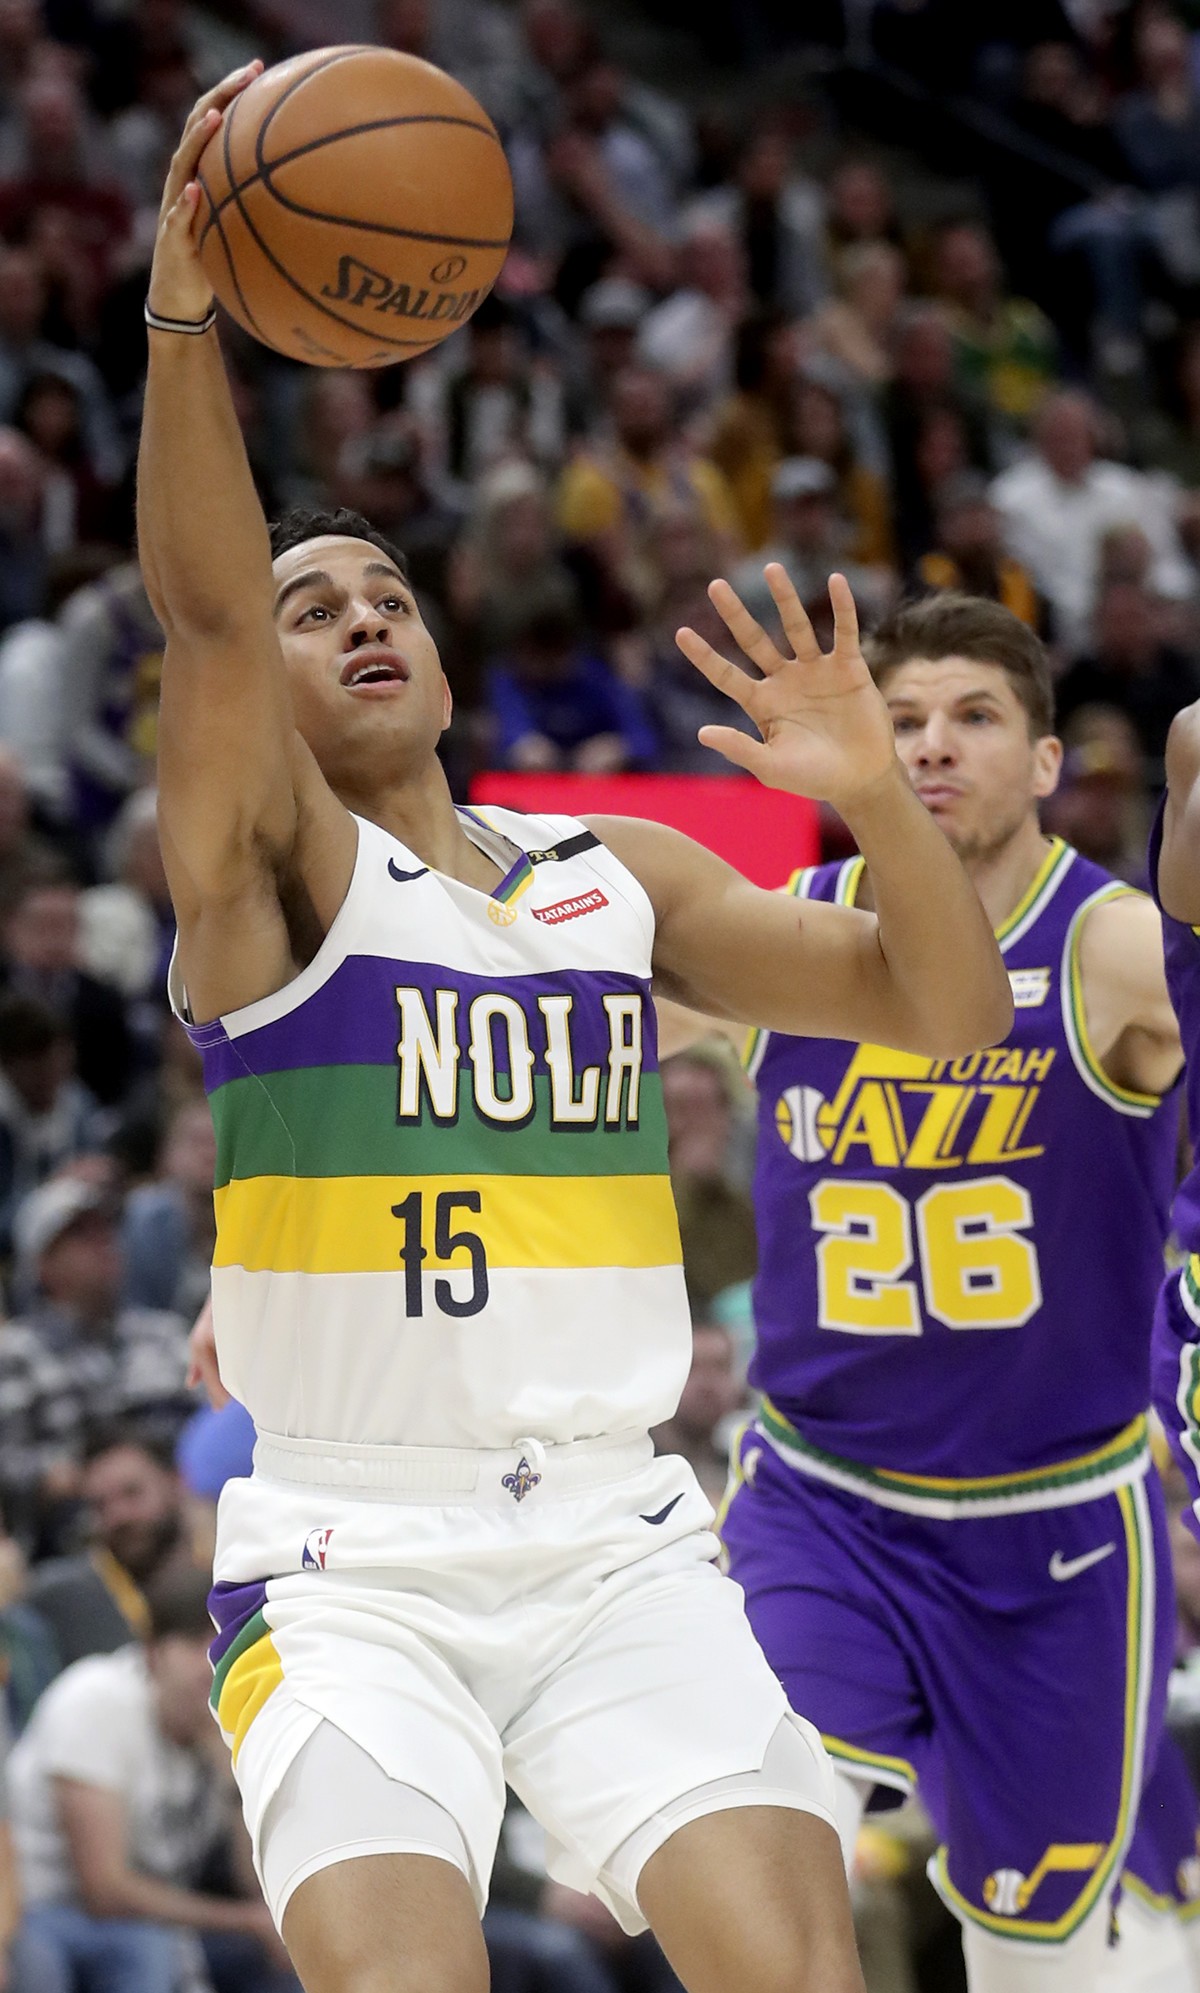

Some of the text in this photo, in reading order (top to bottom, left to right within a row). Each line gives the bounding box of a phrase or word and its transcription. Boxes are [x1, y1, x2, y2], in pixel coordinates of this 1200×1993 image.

[320, 255, 492, 321] SPALDIN
[528, 849, 560, 862] TB
[536, 893, 603, 922] ZATARAIN'S
[395, 986, 643, 1130] NOLA
[948, 1046, 1057, 1082] UTAH
[390, 1190, 490, 1319] 15
[808, 1174, 1043, 1337] 26
